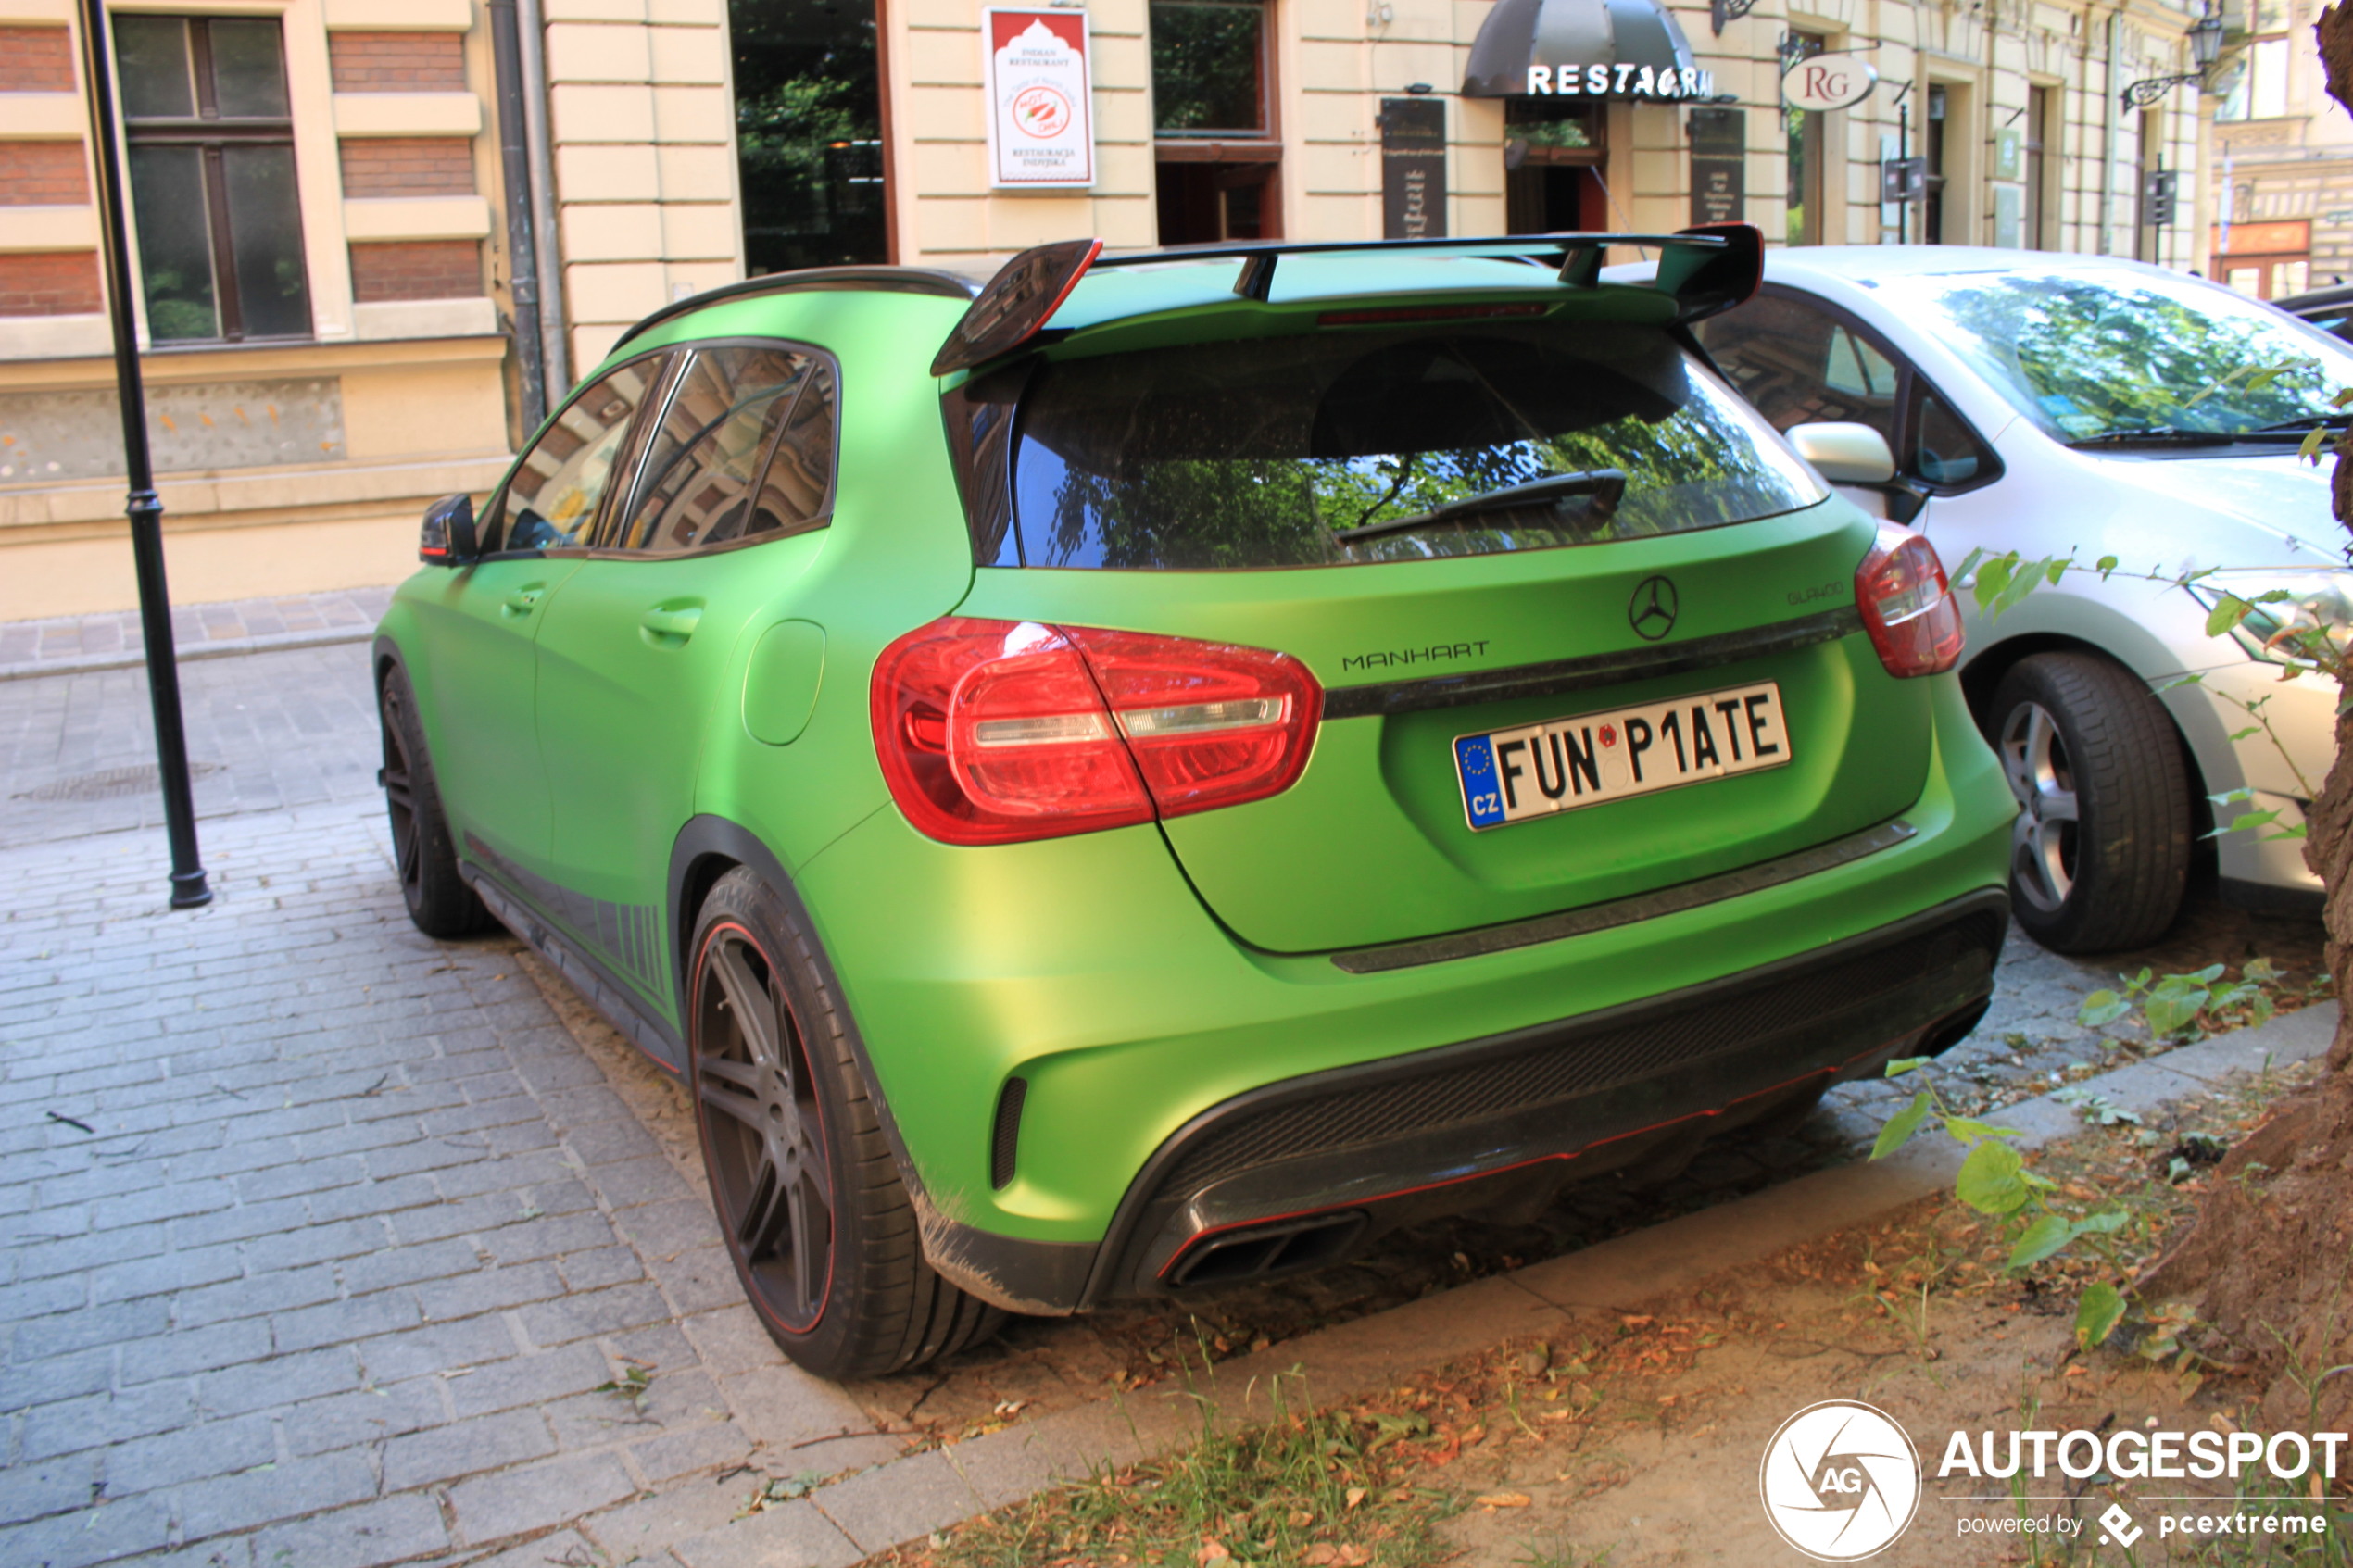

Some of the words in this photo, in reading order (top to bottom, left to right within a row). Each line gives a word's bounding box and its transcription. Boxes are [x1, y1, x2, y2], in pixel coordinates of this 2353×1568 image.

[1009, 57, 1069, 67] RESTAURANT
[1804, 67, 1849, 99] RG
[1012, 148, 1076, 157] RESTAURACJA
[1022, 158, 1067, 168] INDYJSKA
[1342, 640, 1490, 671] MANHART
[1495, 726, 1601, 809] FUN
[1623, 693, 1779, 784] P1ATE
[1472, 792, 1500, 816] CZ
